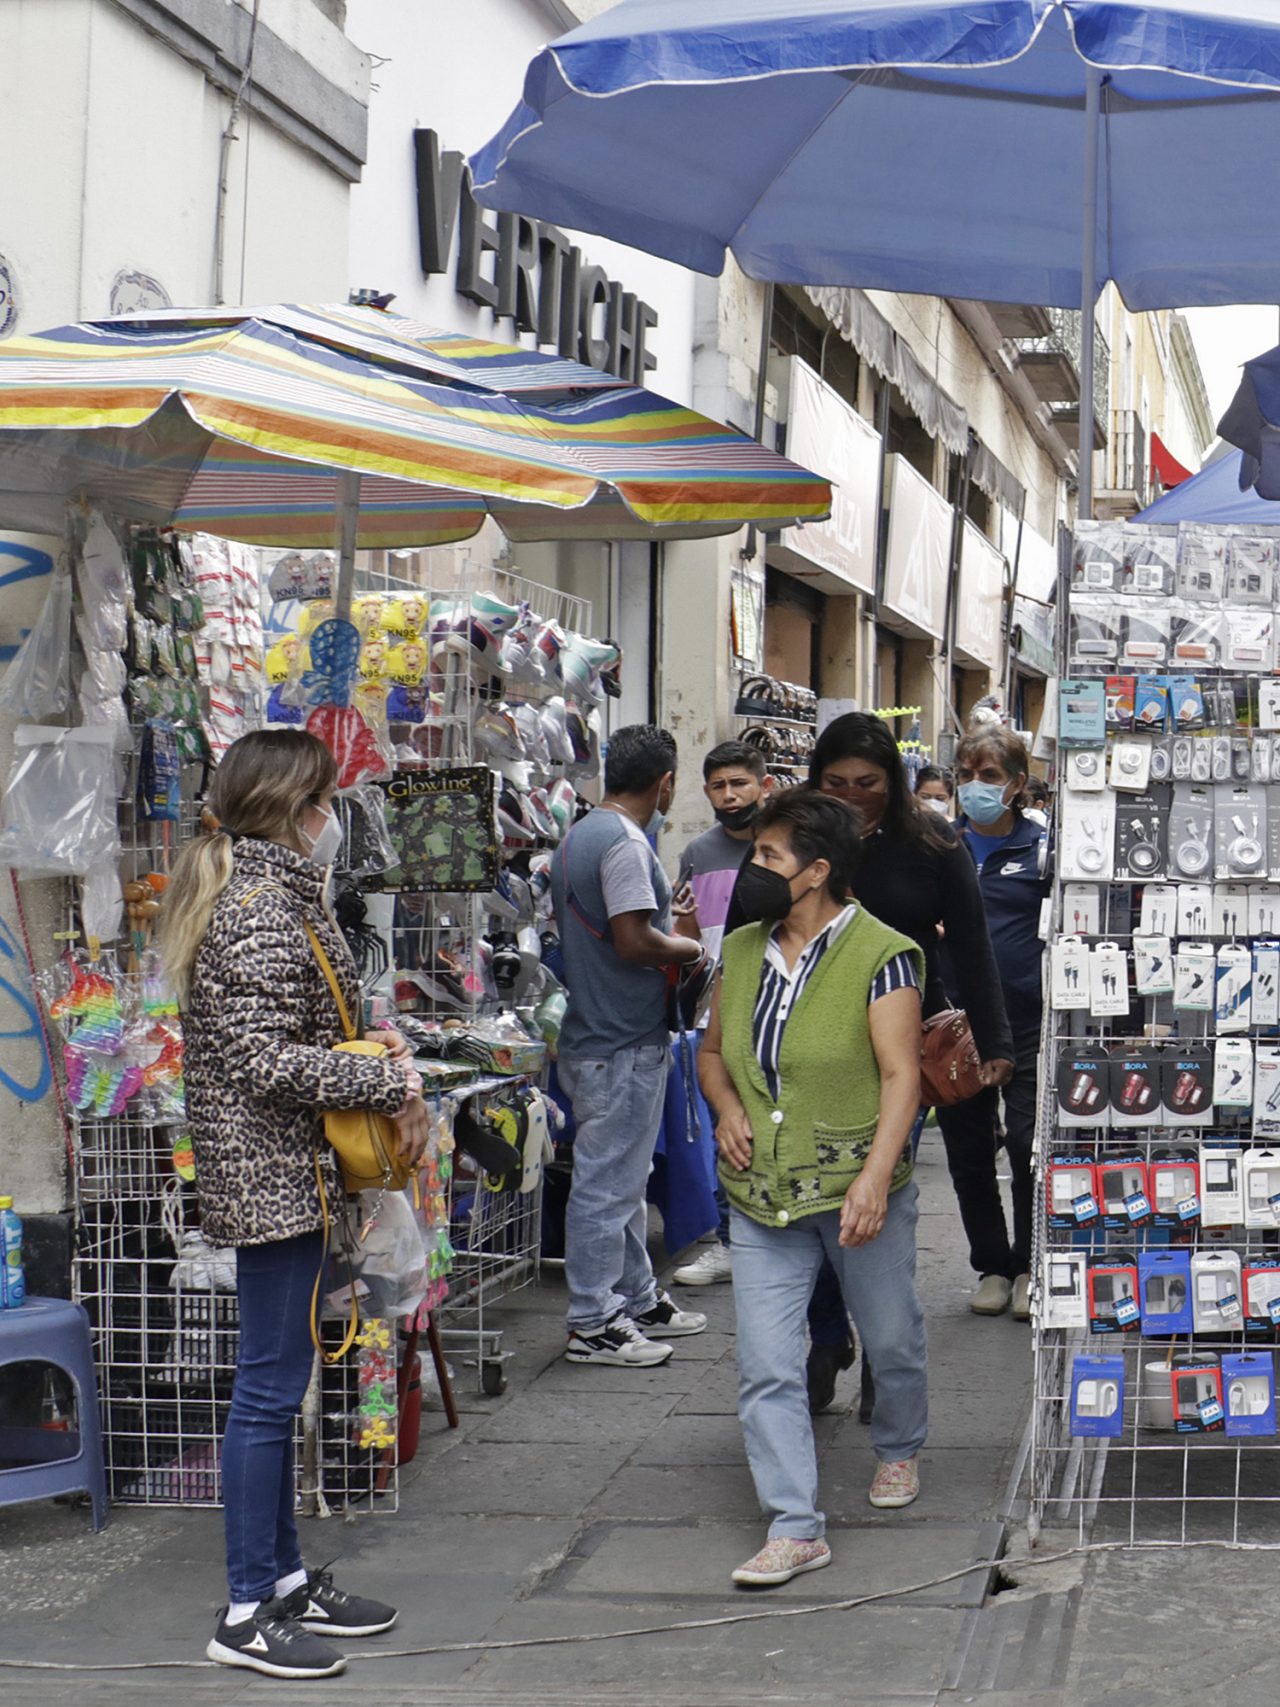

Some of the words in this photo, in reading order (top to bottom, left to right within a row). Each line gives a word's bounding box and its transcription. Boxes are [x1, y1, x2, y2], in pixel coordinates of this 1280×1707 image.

[413, 128, 658, 386] VERTICHE
[276, 586, 304, 598] KN95
[272, 672, 288, 681] KN
[360, 669, 380, 679] N95
[387, 773, 473, 798] Glowing
